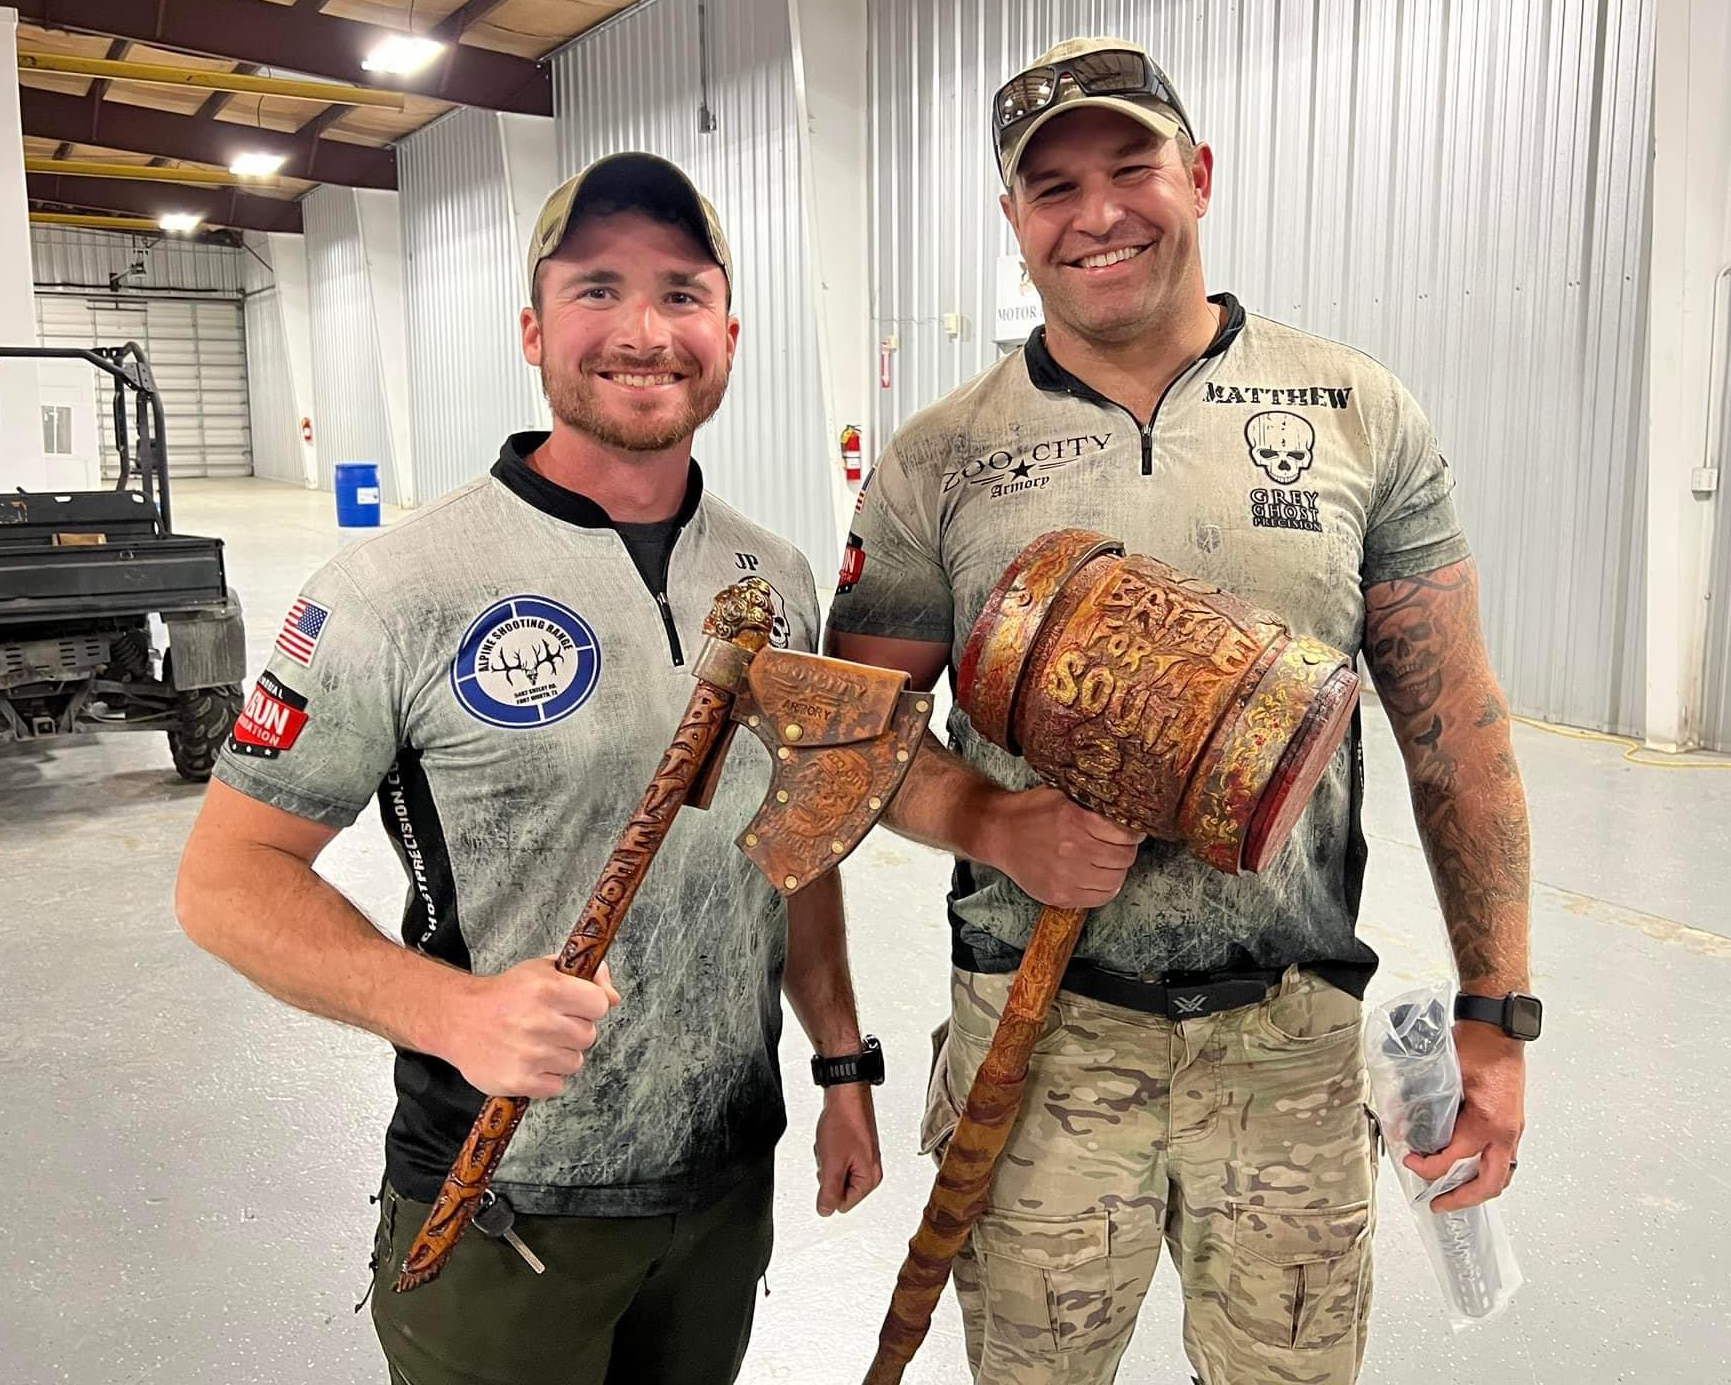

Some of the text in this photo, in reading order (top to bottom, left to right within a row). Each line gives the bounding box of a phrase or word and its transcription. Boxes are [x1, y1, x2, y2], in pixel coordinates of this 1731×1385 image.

[1202, 382, 1353, 409] MATTHEW
[942, 433, 1113, 493] ZOO CITY
[990, 476, 1050, 499] Armory
[1250, 488, 1319, 509] GREY
[1251, 503, 1319, 522] GHOST
[1253, 517, 1322, 532] PRECISION
[735, 552, 758, 571] JP
[478, 618, 573, 672] ALPINE SHOOTING RANGE
